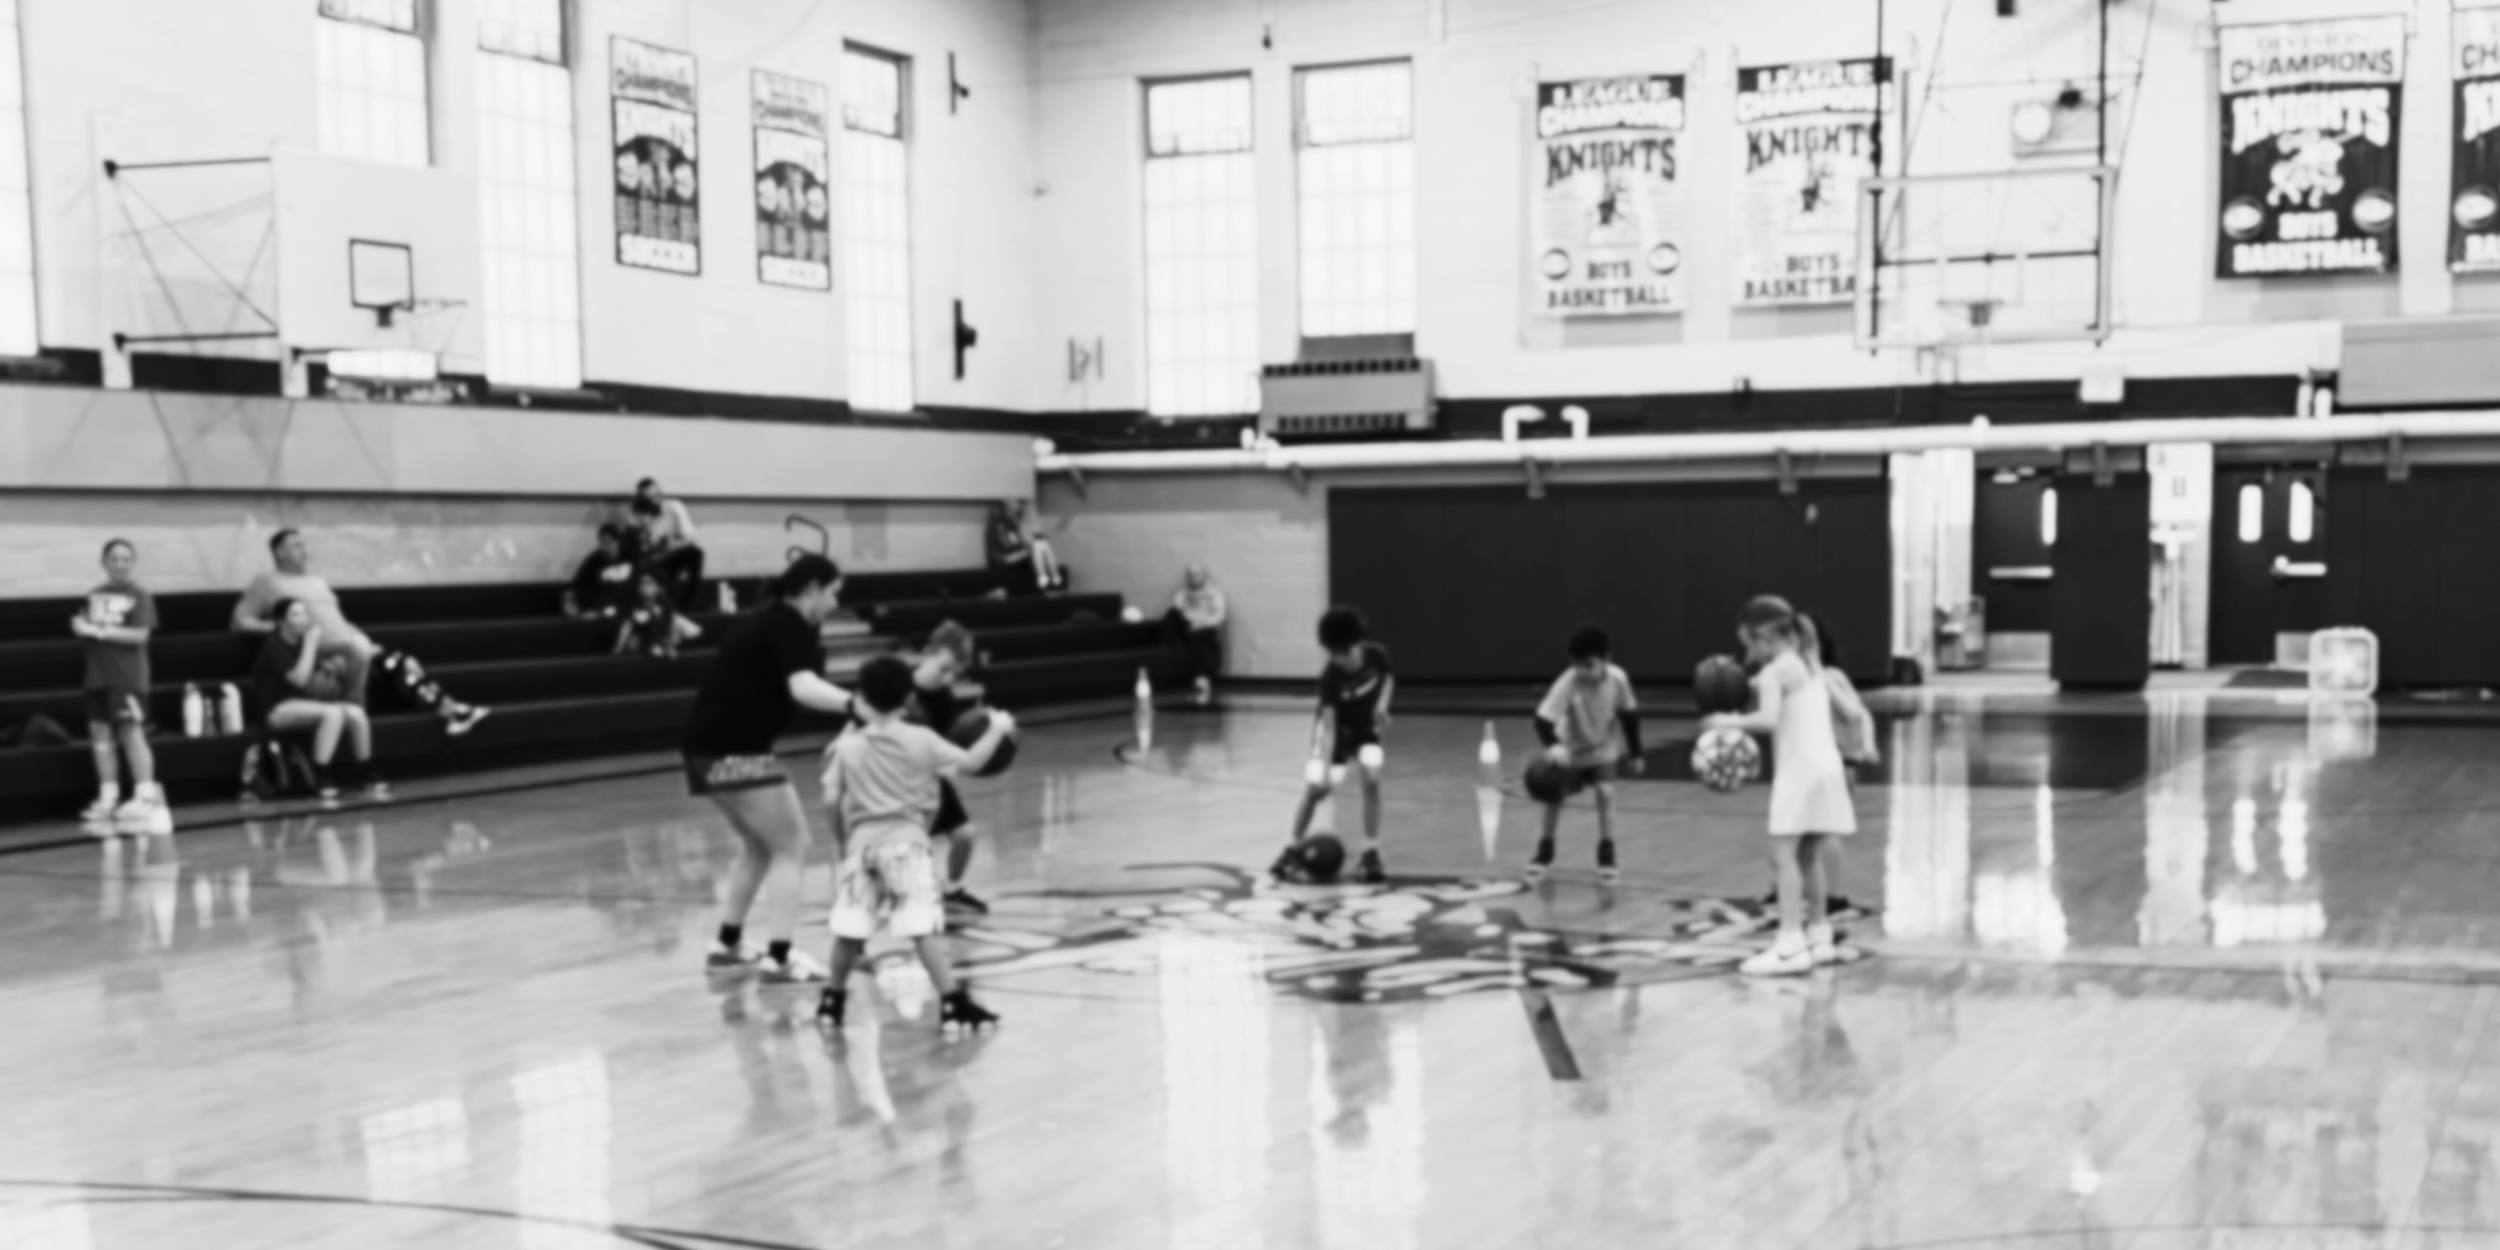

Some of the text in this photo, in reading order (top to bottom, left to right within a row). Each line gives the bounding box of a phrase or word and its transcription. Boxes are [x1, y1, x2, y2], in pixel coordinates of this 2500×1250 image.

[2231, 49, 2394, 85] CHAMPIONS
[1539, 97, 1683, 138] CHAMPIONS
[2231, 87, 2391, 154] KNIGHTS
[1546, 137, 1676, 188] KNIGHTS
[1588, 261, 1632, 280] BOYS
[1786, 253, 1839, 273] BOYS
[2233, 239, 2384, 272] BASKETBALL
[1547, 285, 1672, 308] BASKETBALL
[1744, 275, 1856, 300] BASKETBA
